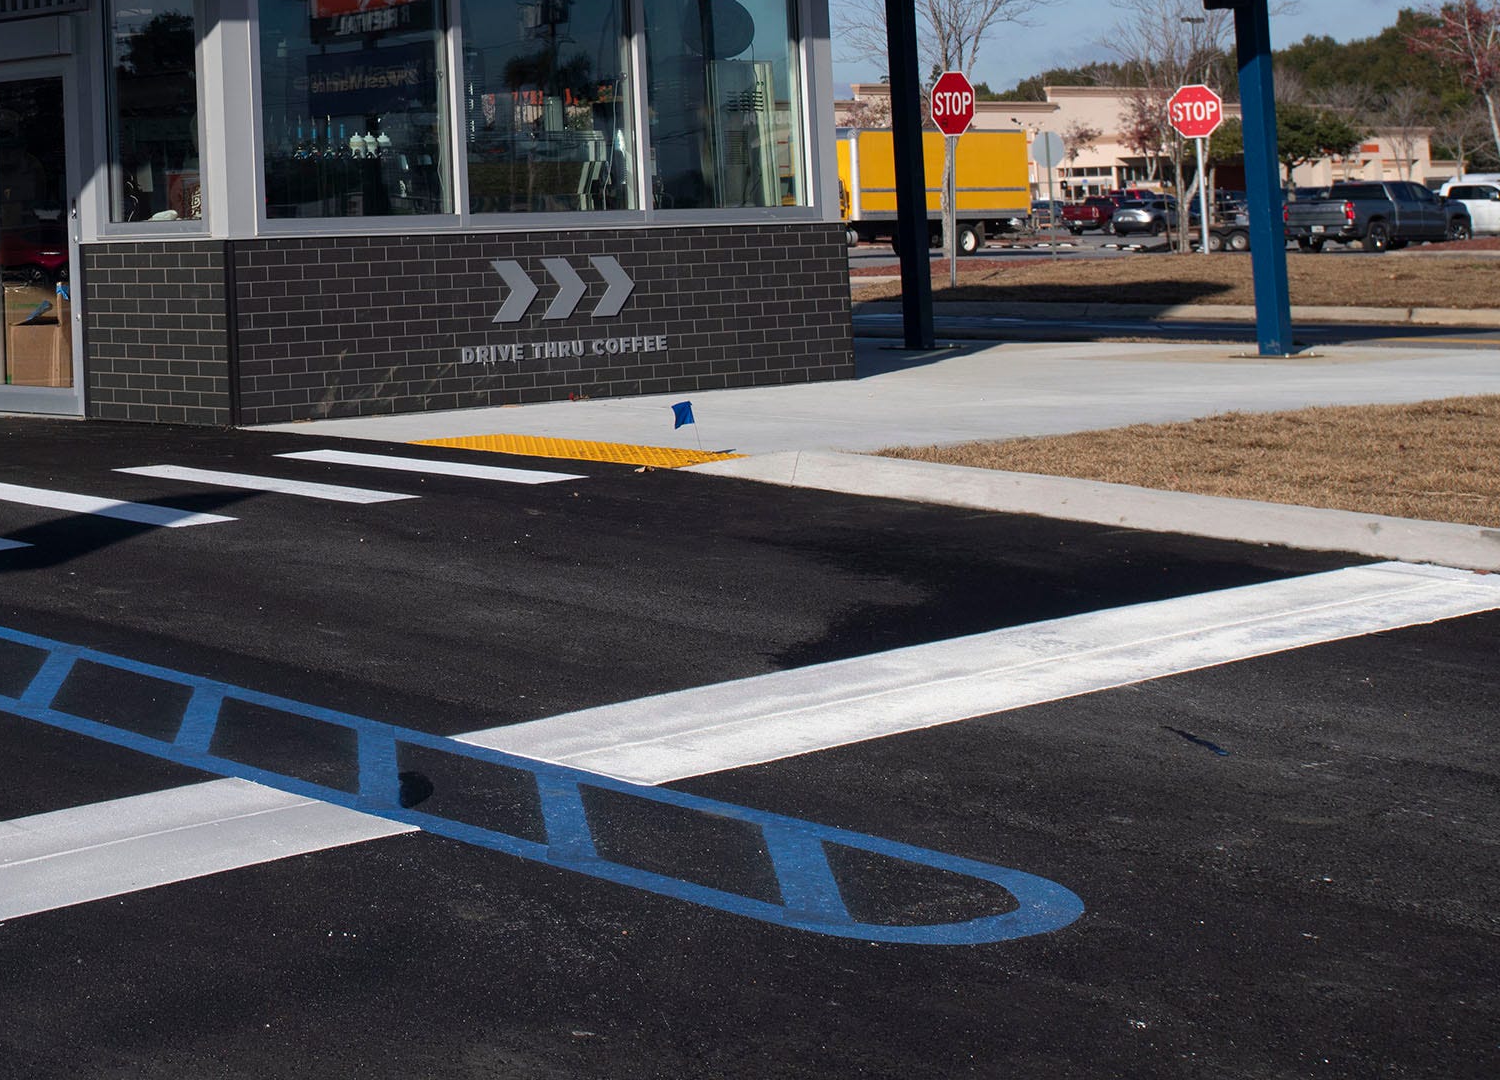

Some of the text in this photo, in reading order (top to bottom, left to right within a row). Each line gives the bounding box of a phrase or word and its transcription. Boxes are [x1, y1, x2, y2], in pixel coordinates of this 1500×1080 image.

[934, 91, 972, 116] STOP
[1172, 100, 1218, 122] STOP
[461, 335, 668, 364] DRIVE THRU COFFEE
